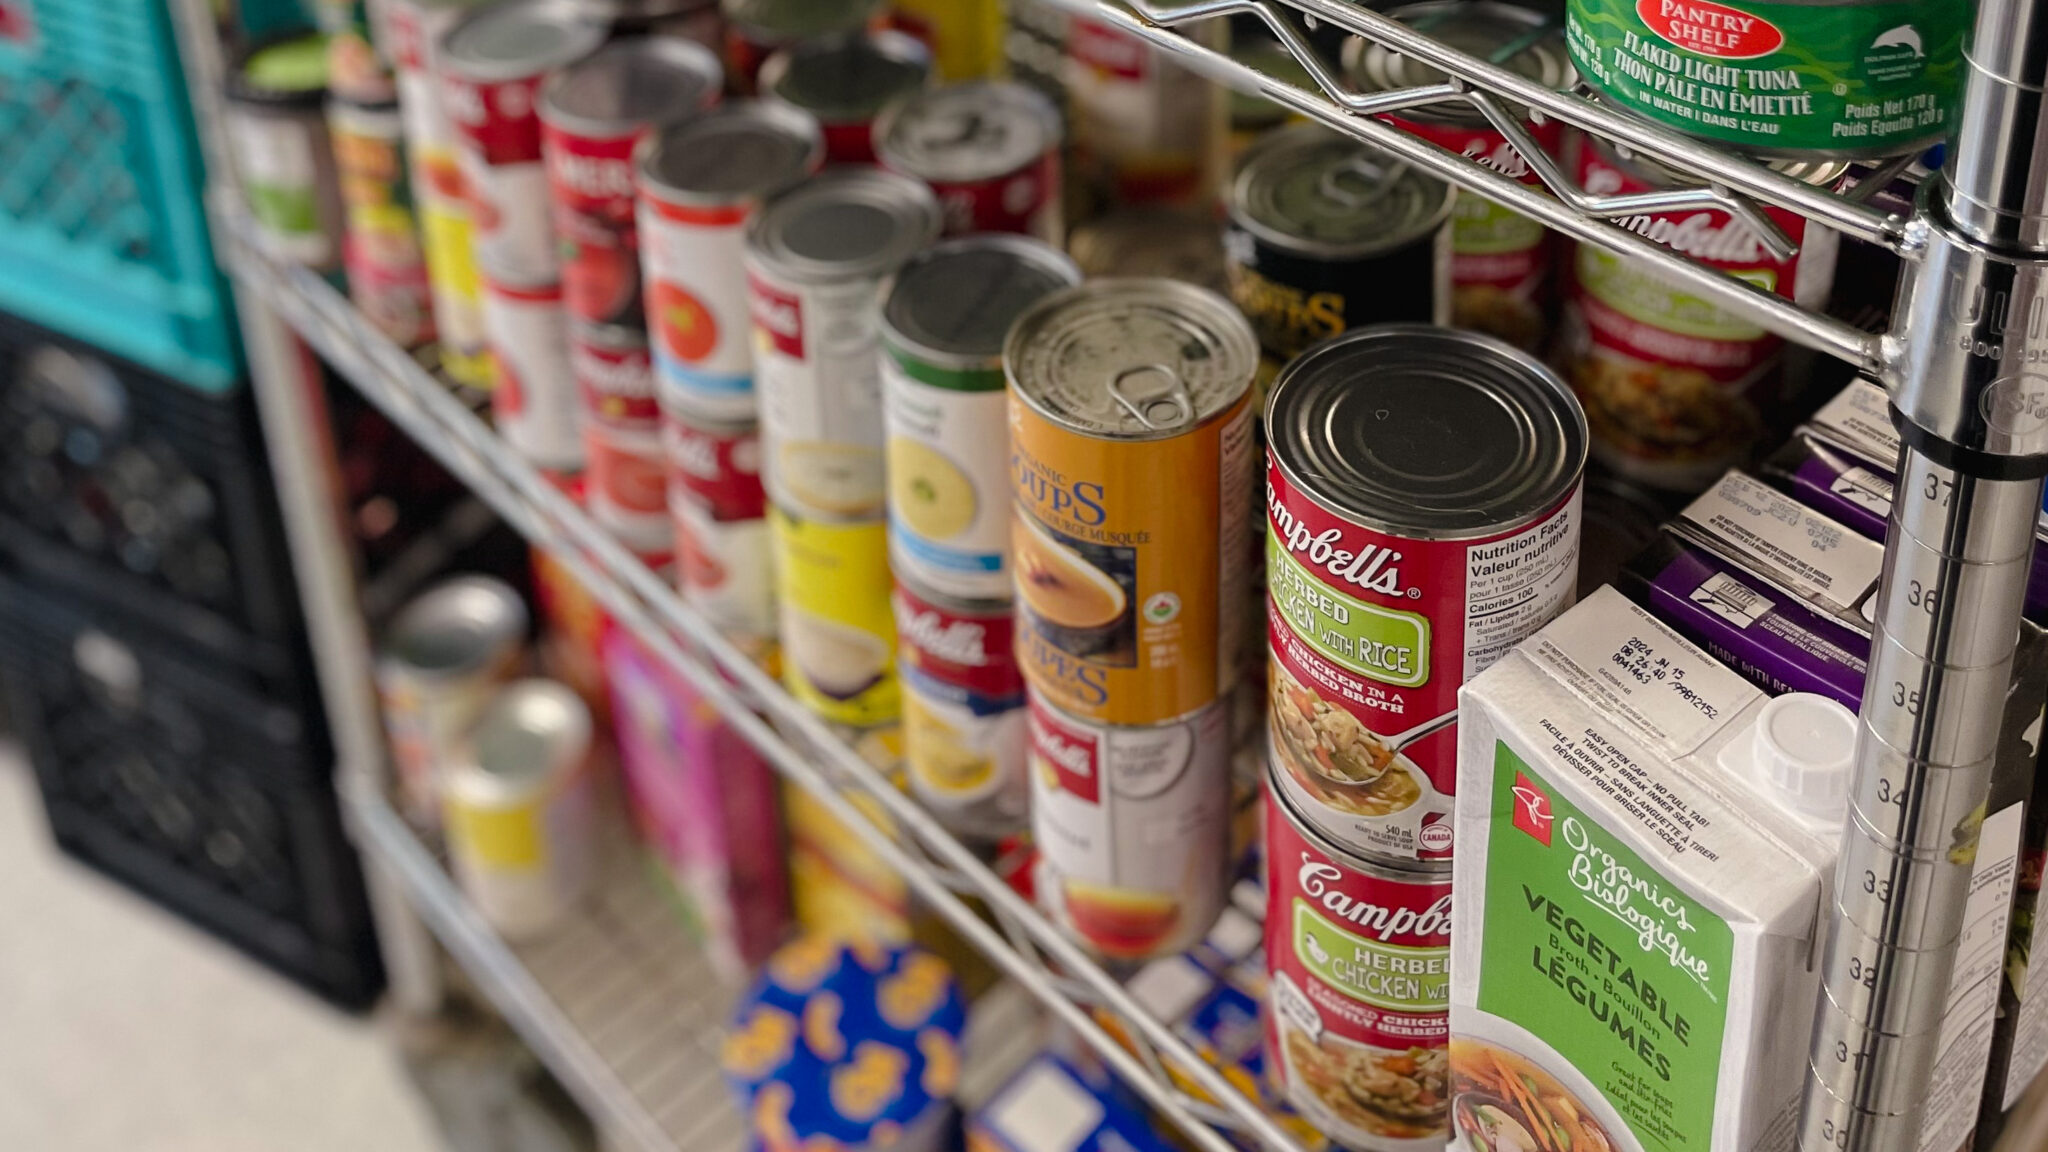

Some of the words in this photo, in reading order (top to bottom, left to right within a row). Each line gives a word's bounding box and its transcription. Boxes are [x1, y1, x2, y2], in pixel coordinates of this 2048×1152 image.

[1661, 0, 1754, 34] PANTRY
[1669, 21, 1740, 49] SHELF
[1623, 30, 1682, 73] FLAKED
[1685, 59, 1741, 88] LIGHT
[1744, 69, 1801, 90] TUNA
[1614, 47, 1652, 86] THON
[1655, 72, 1699, 104] PÂLE
[1700, 87, 1725, 110] EN
[1729, 89, 1815, 116] ÉMIETTÉ
[1639, 91, 1651, 104] IN
[1653, 95, 1692, 120] WATER
[1703, 112, 1737, 129] DANS
[1741, 120, 1780, 134] L'EAU
[1832, 122, 1867, 137] Poids
[1918, 110, 1935, 125] 120
[1937, 109, 1943, 123] g
[1845, 103, 1880, 118] Poids
[1884, 100, 1904, 116] Net
[1907, 95, 1926, 109] 170
[1928, 95, 1935, 109] g
[1924, 472, 1953, 507] 37
[1471, 534, 1536, 562] Nutrition
[1540, 511, 1568, 539] Facts
[1472, 556, 1520, 577] Valeur
[1525, 523, 1569, 562] nutritive
[1276, 550, 1349, 625] HERBED
[1469, 590, 1491, 600] pour
[1502, 580, 1524, 592] tasse
[1470, 580, 1487, 589] Per
[1497, 574, 1513, 584] cup
[1908, 580, 1937, 615] 36
[1469, 597, 1514, 613] Calories
[1517, 587, 1533, 600] 100
[1468, 619, 1483, 628] Fat
[1490, 609, 1520, 625] Lipides
[1476, 621, 1515, 636] Saturated
[1758, 620, 1785, 637] SCEAU
[1319, 623, 1354, 656] WITH
[1359, 637, 1411, 674] RICE
[1468, 636, 1523, 657] Carbohydrate
[1484, 631, 1507, 643] Trans
[1290, 638, 1363, 692] CHICKEN
[1368, 687, 1385, 699] IN
[1391, 694, 1404, 703] A
[1475, 652, 1496, 664] Fibre
[1611, 652, 1652, 685] 0041463
[1628, 636, 1654, 657] 2024
[1672, 667, 1685, 680] 15
[1741, 660, 1770, 683] WITH
[1343, 688, 1404, 714] BROTH
[1893, 681, 1920, 715] 35
[1539, 718, 1569, 744] FACILE
[1566, 742, 1576, 750] À
[1573, 748, 1605, 775] OUVRIR
[1609, 777, 1635, 798] SANS
[1632, 795, 1682, 837] LANGUETTE
[1681, 834, 1691, 844] À
[1689, 840, 1720, 863] TIRER!
[1582, 737, 1608, 760] TWIST
[1608, 758, 1620, 769] TO
[1618, 768, 1650, 792] BREAK
[1647, 790, 1676, 814] INNER
[1672, 811, 1696, 832] SEAL
[1584, 728, 1608, 746] EASY
[1606, 744, 1630, 764] OPEN
[1628, 761, 1648, 777] CAP
[1652, 782, 1669, 795] NO
[1666, 793, 1687, 813] PULL
[1691, 810, 1711, 829] TAB!
[1552, 743, 1593, 777] DÉVISSER
[1590, 775, 1615, 796] POUR
[1613, 793, 1647, 819] BRISER
[1644, 817, 1655, 829] LE
[1655, 829, 1686, 853] SCEAU
[1386, 825, 1400, 836] 540
[1401, 829, 1412, 838] mL
[1423, 833, 1451, 841] CANADA
[1561, 815, 1697, 933] Organics
[1863, 869, 1890, 903] 33
[1567, 853, 1710, 982] Biologique
[1332, 957, 1419, 999] CHICKEN
[1521, 883, 1692, 1048] VEGETABLE
[1548, 933, 1591, 977] Broth
[1602, 971, 1662, 1041] Bouillon
[1531, 944, 1671, 1083] LÉGUMES
